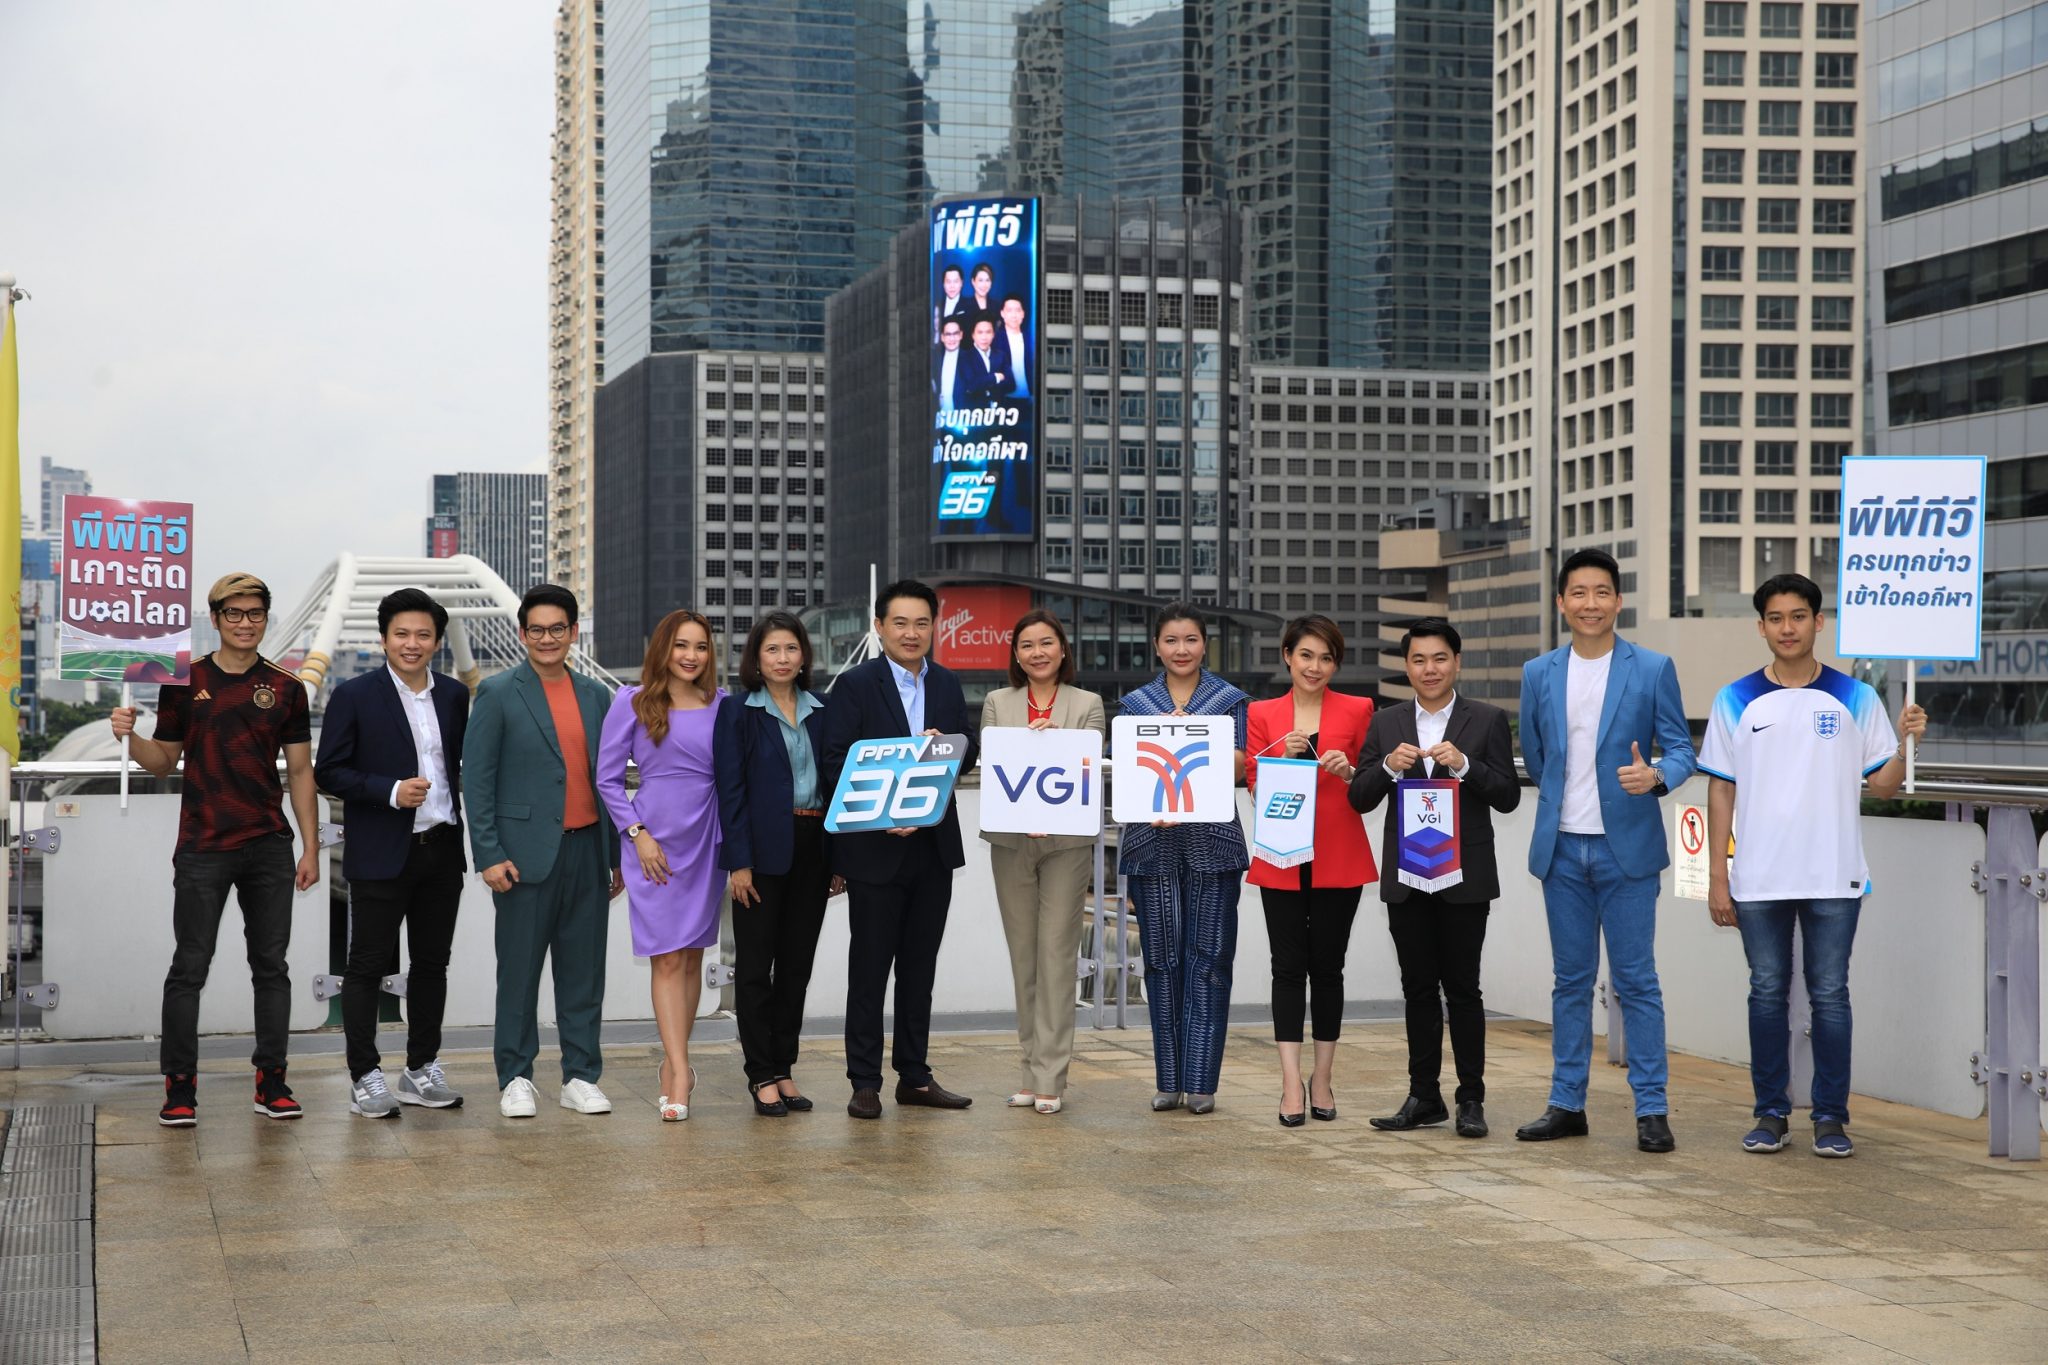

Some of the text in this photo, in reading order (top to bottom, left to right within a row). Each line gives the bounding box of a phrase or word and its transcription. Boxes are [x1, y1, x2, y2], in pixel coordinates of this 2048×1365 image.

[950, 471, 987, 486] PPTV
[940, 487, 989, 515] 36
[1848, 495, 1977, 538] พีพีทีวี
[72, 511, 187, 554] พีพีทีวี
[70, 556, 186, 589] เกาะติด
[1846, 547, 1971, 580] ครบทุกข่าว
[1845, 583, 1973, 607] เข้าใจคอกีฬา
[960, 625, 1013, 645] active
[1136, 724, 1210, 737] BTS
[856, 736, 954, 764] PPTV HD
[835, 765, 949, 824] 36
[1267, 801, 1300, 816] 36
